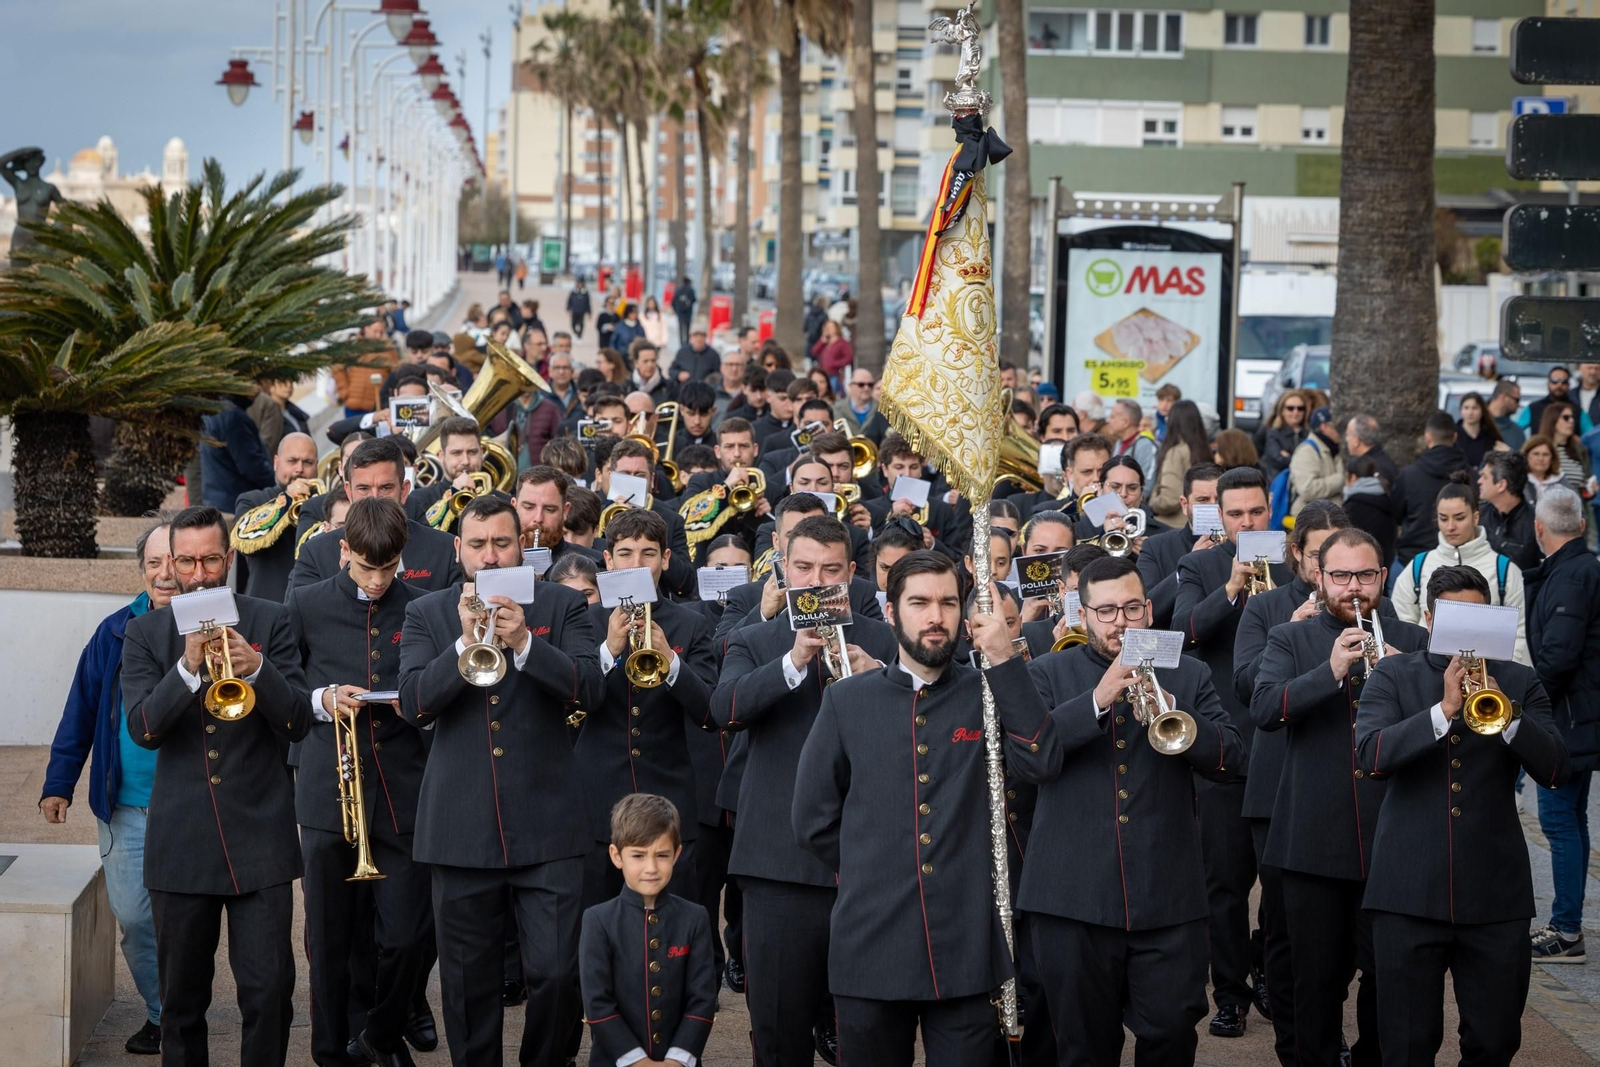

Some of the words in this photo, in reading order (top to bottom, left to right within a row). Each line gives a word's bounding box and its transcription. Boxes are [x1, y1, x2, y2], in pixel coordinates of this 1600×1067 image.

[1123, 266, 1205, 296] MAS
[403, 569, 431, 580] Polillas
[792, 611, 829, 622] POLILLAS
[951, 726, 982, 743] Polill
